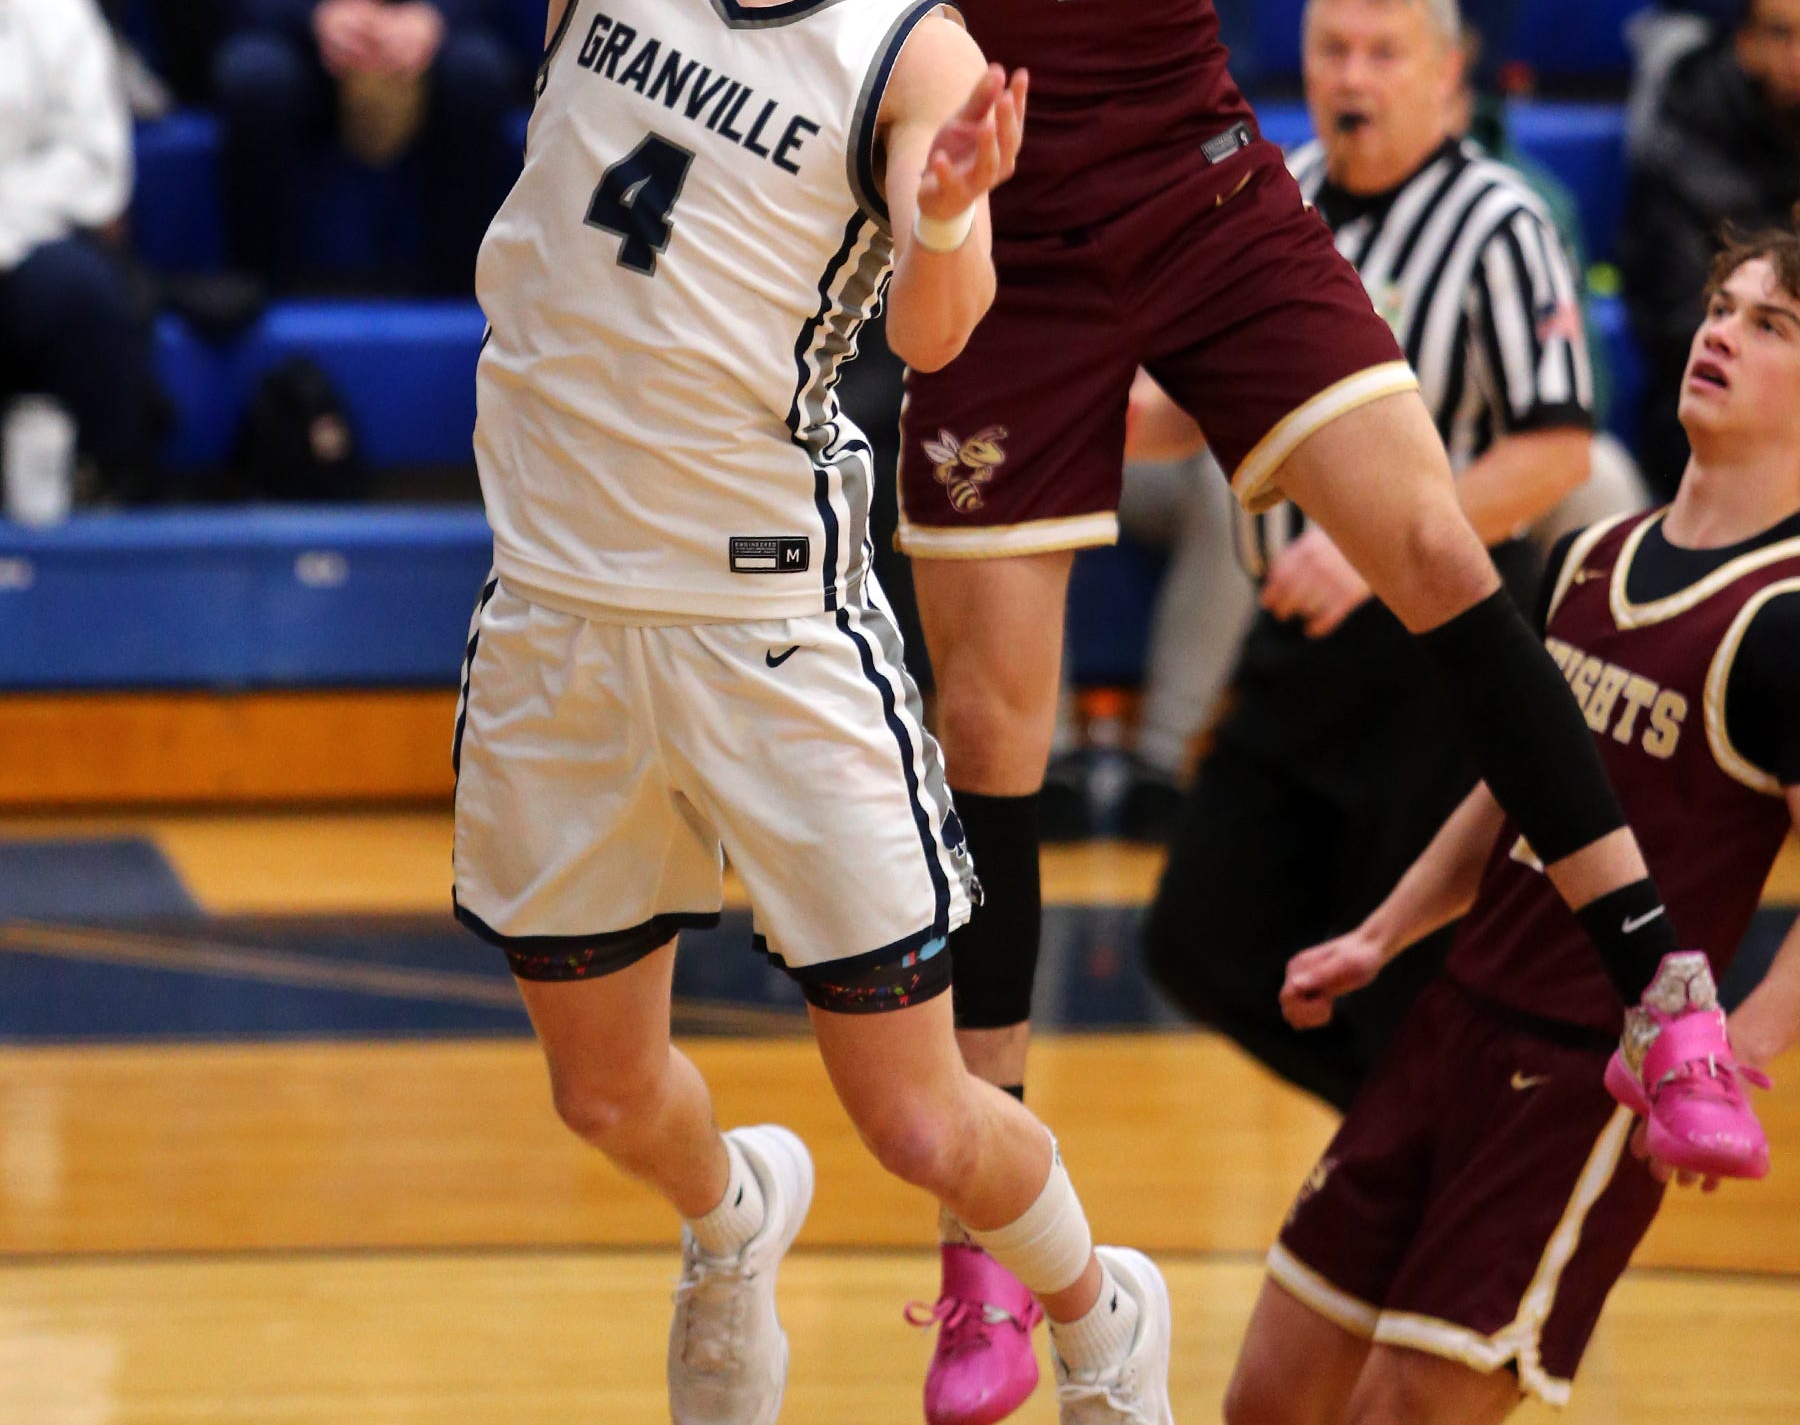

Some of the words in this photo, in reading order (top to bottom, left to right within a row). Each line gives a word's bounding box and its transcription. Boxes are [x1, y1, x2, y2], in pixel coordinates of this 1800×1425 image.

[576, 12, 821, 176] GRANVILLE
[582, 130, 696, 278] 4
[786, 548, 800, 563] M
